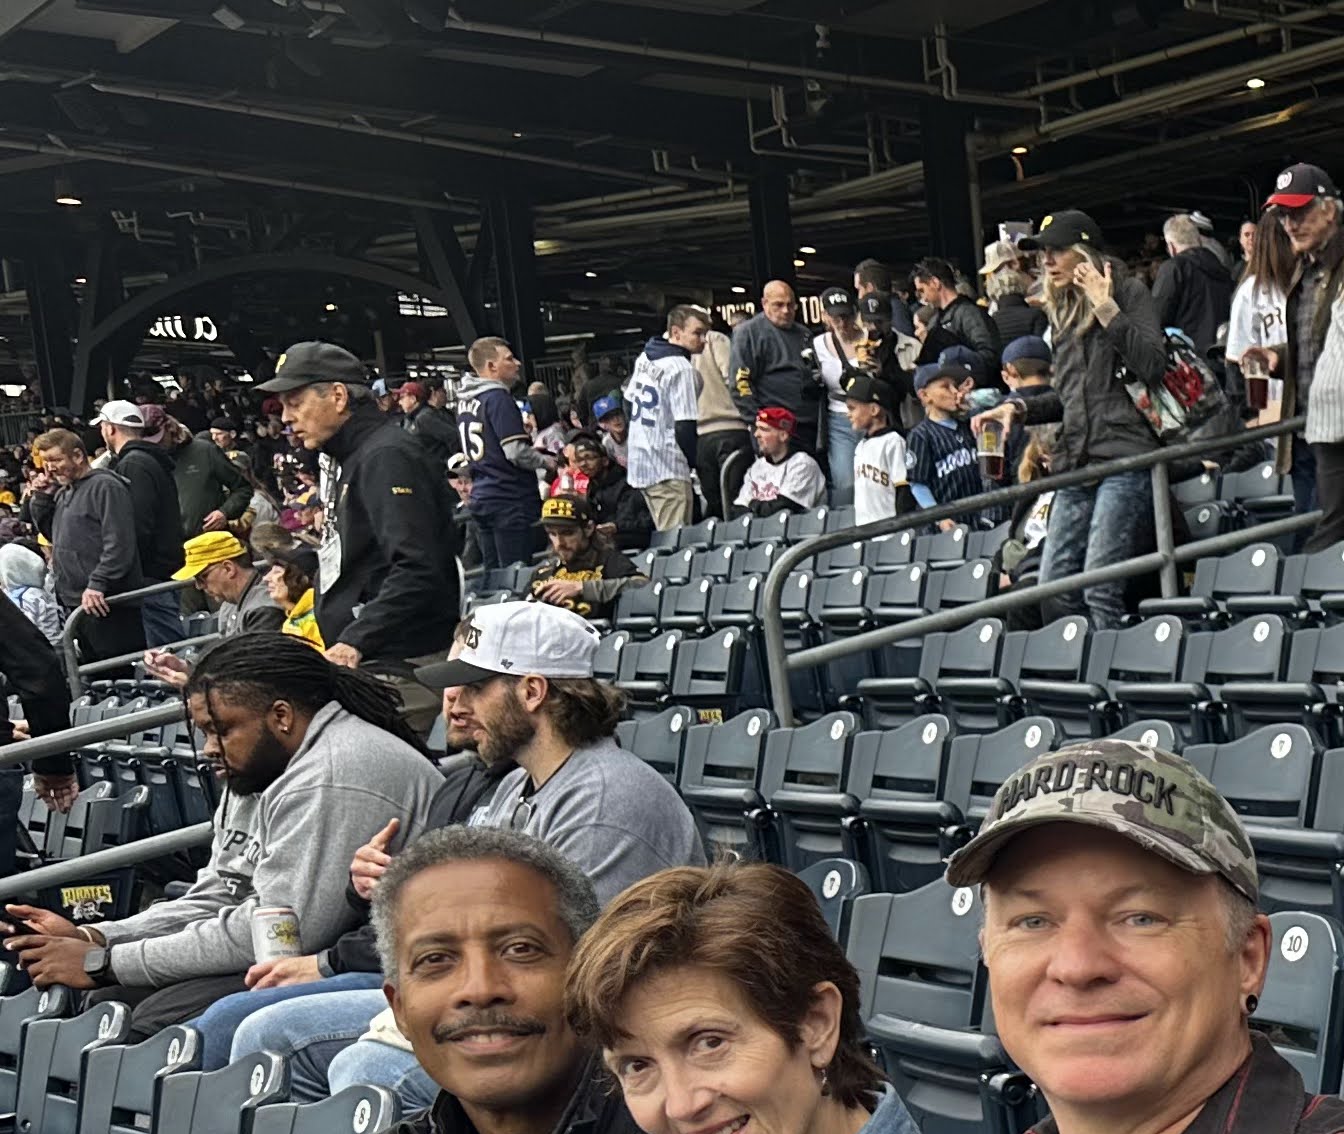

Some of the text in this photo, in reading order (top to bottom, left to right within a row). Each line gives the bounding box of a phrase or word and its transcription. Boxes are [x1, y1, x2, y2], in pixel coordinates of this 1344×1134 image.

[459, 420, 485, 461] 15
[997, 759, 1177, 819] HARD ROCK
[829, 868, 836, 885] 7
[61, 884, 113, 907] PIRATES
[958, 892, 966, 908] 8
[1286, 935, 1301, 954] 10
[357, 1109, 367, 1126] 8
